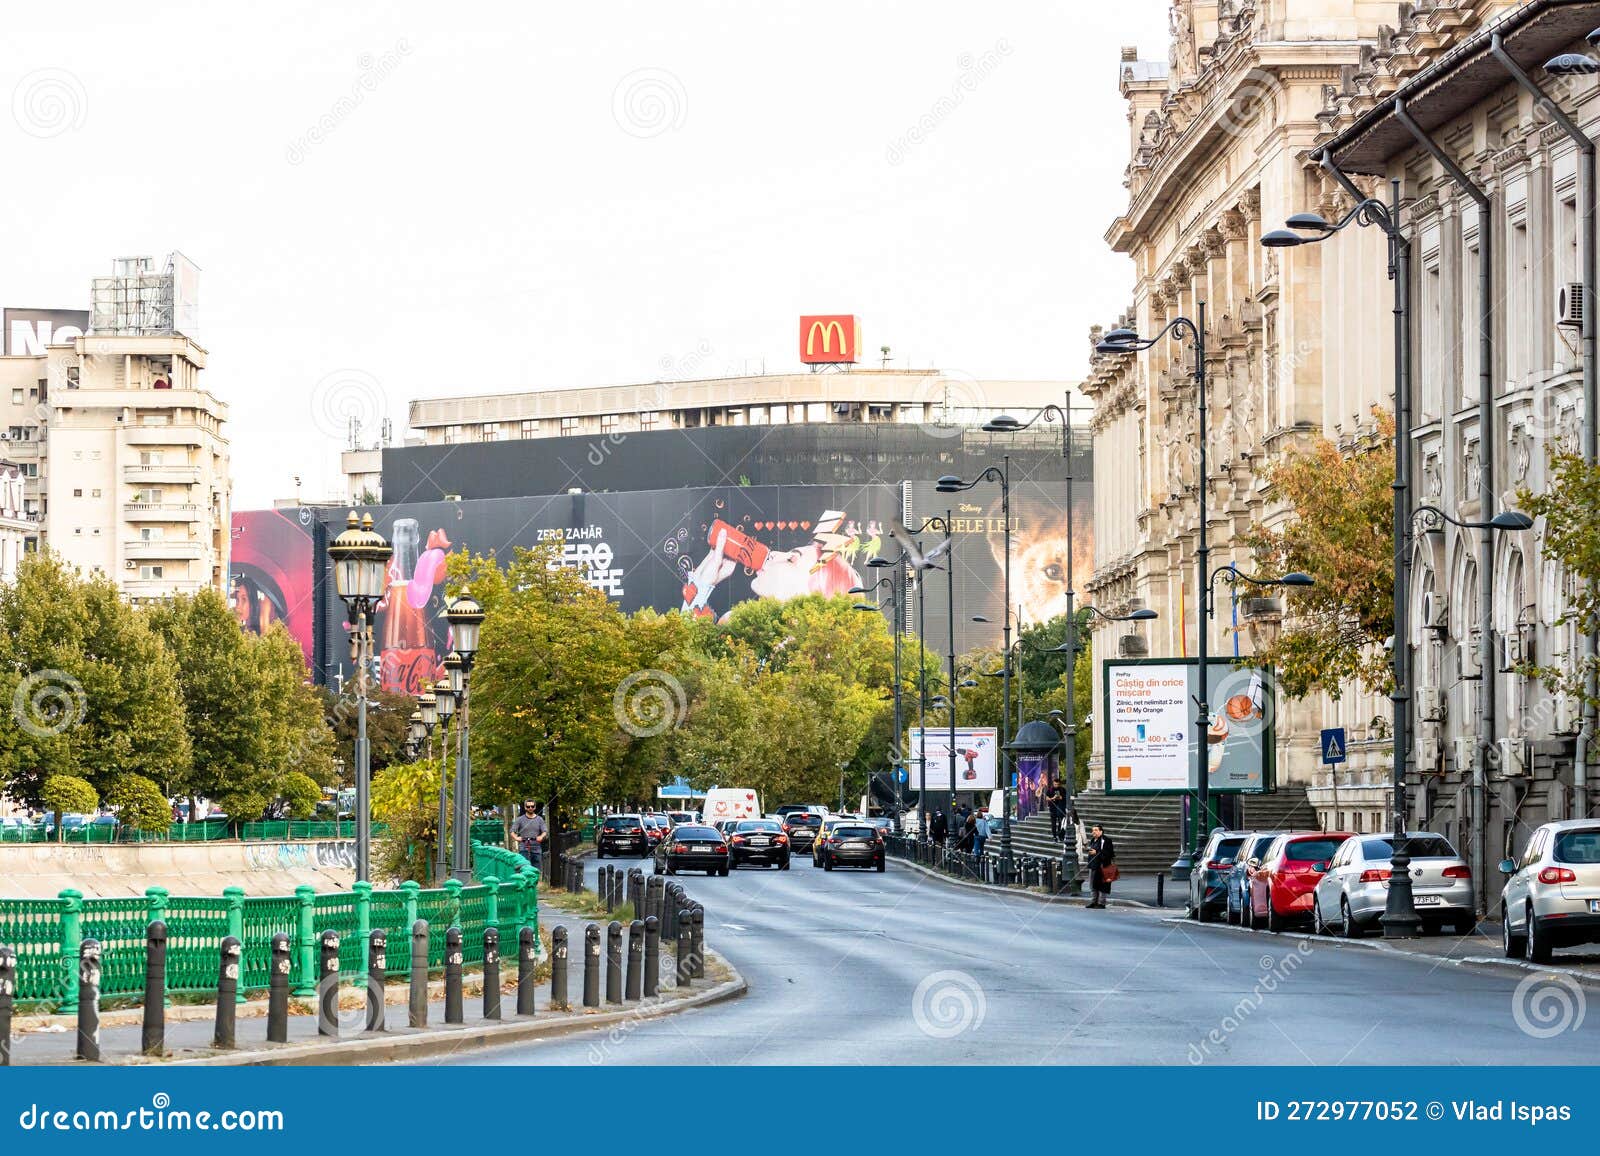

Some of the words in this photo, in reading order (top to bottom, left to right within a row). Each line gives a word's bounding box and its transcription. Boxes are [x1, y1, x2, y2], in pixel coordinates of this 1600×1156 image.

[537, 529, 563, 541] ZERO
[1146, 679, 1160, 687] din
[1162, 679, 1184, 687] orice
[1148, 735, 1161, 743] 400
